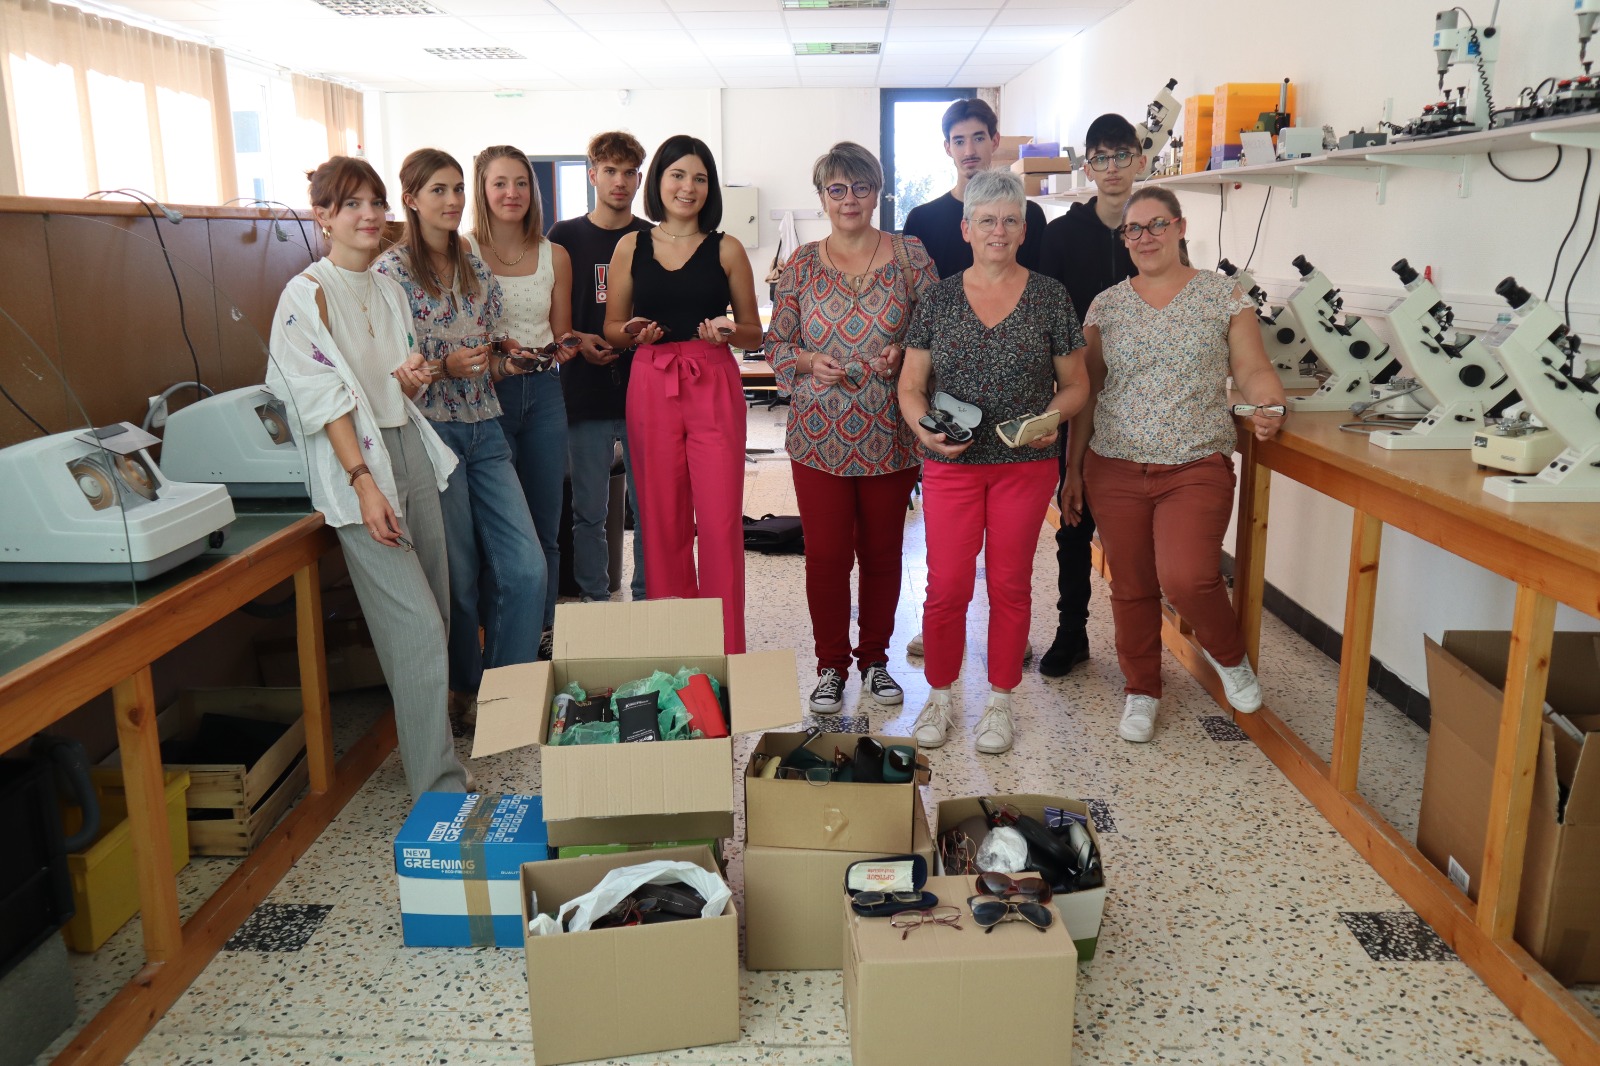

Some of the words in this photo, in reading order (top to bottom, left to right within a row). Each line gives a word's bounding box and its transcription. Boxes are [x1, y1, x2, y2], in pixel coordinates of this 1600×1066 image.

[444, 794, 480, 842] GREENING
[430, 822, 449, 841] NEW
[404, 859, 475, 869] GREENING
